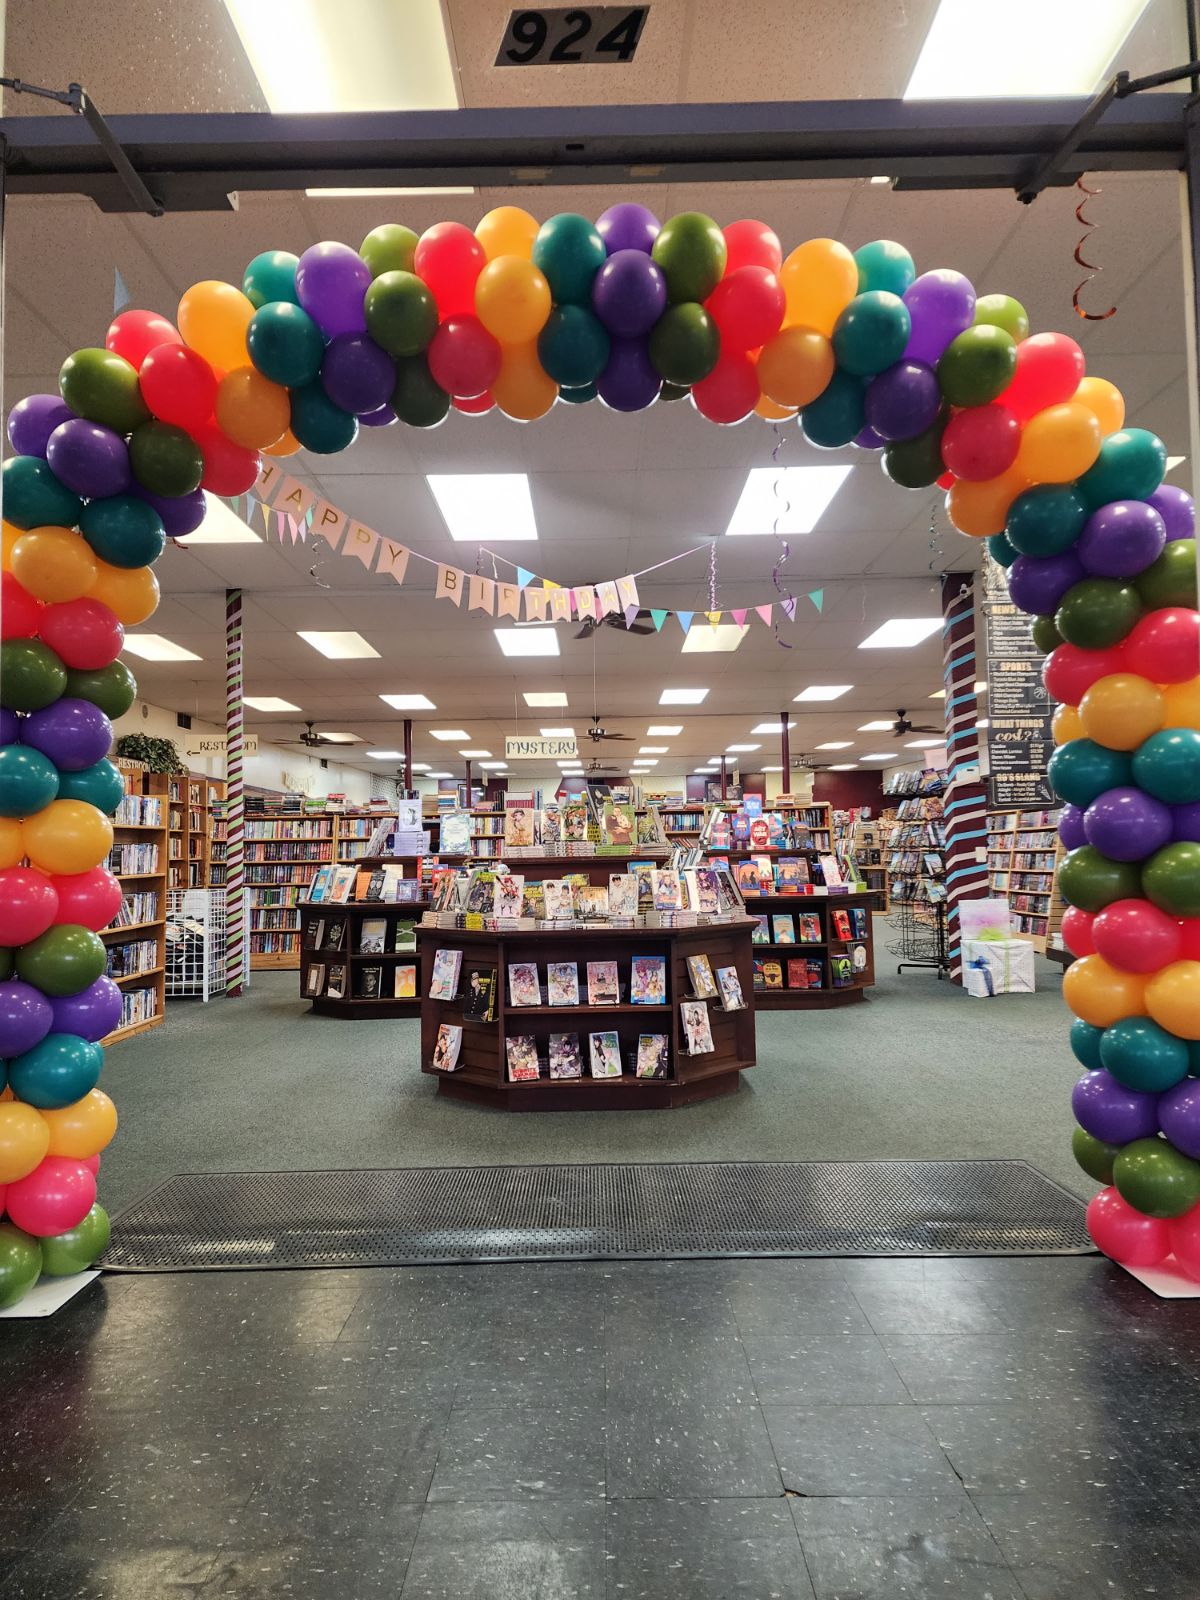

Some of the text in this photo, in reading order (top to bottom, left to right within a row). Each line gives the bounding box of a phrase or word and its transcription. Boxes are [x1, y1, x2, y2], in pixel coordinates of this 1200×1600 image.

[506, 9, 645, 62] 924
[262, 467, 403, 565] HAPPY
[444, 570, 634, 609] BIRTHDAY
[1000, 661, 1032, 671] SPORTS
[506, 741, 576, 754] MYSTERY
